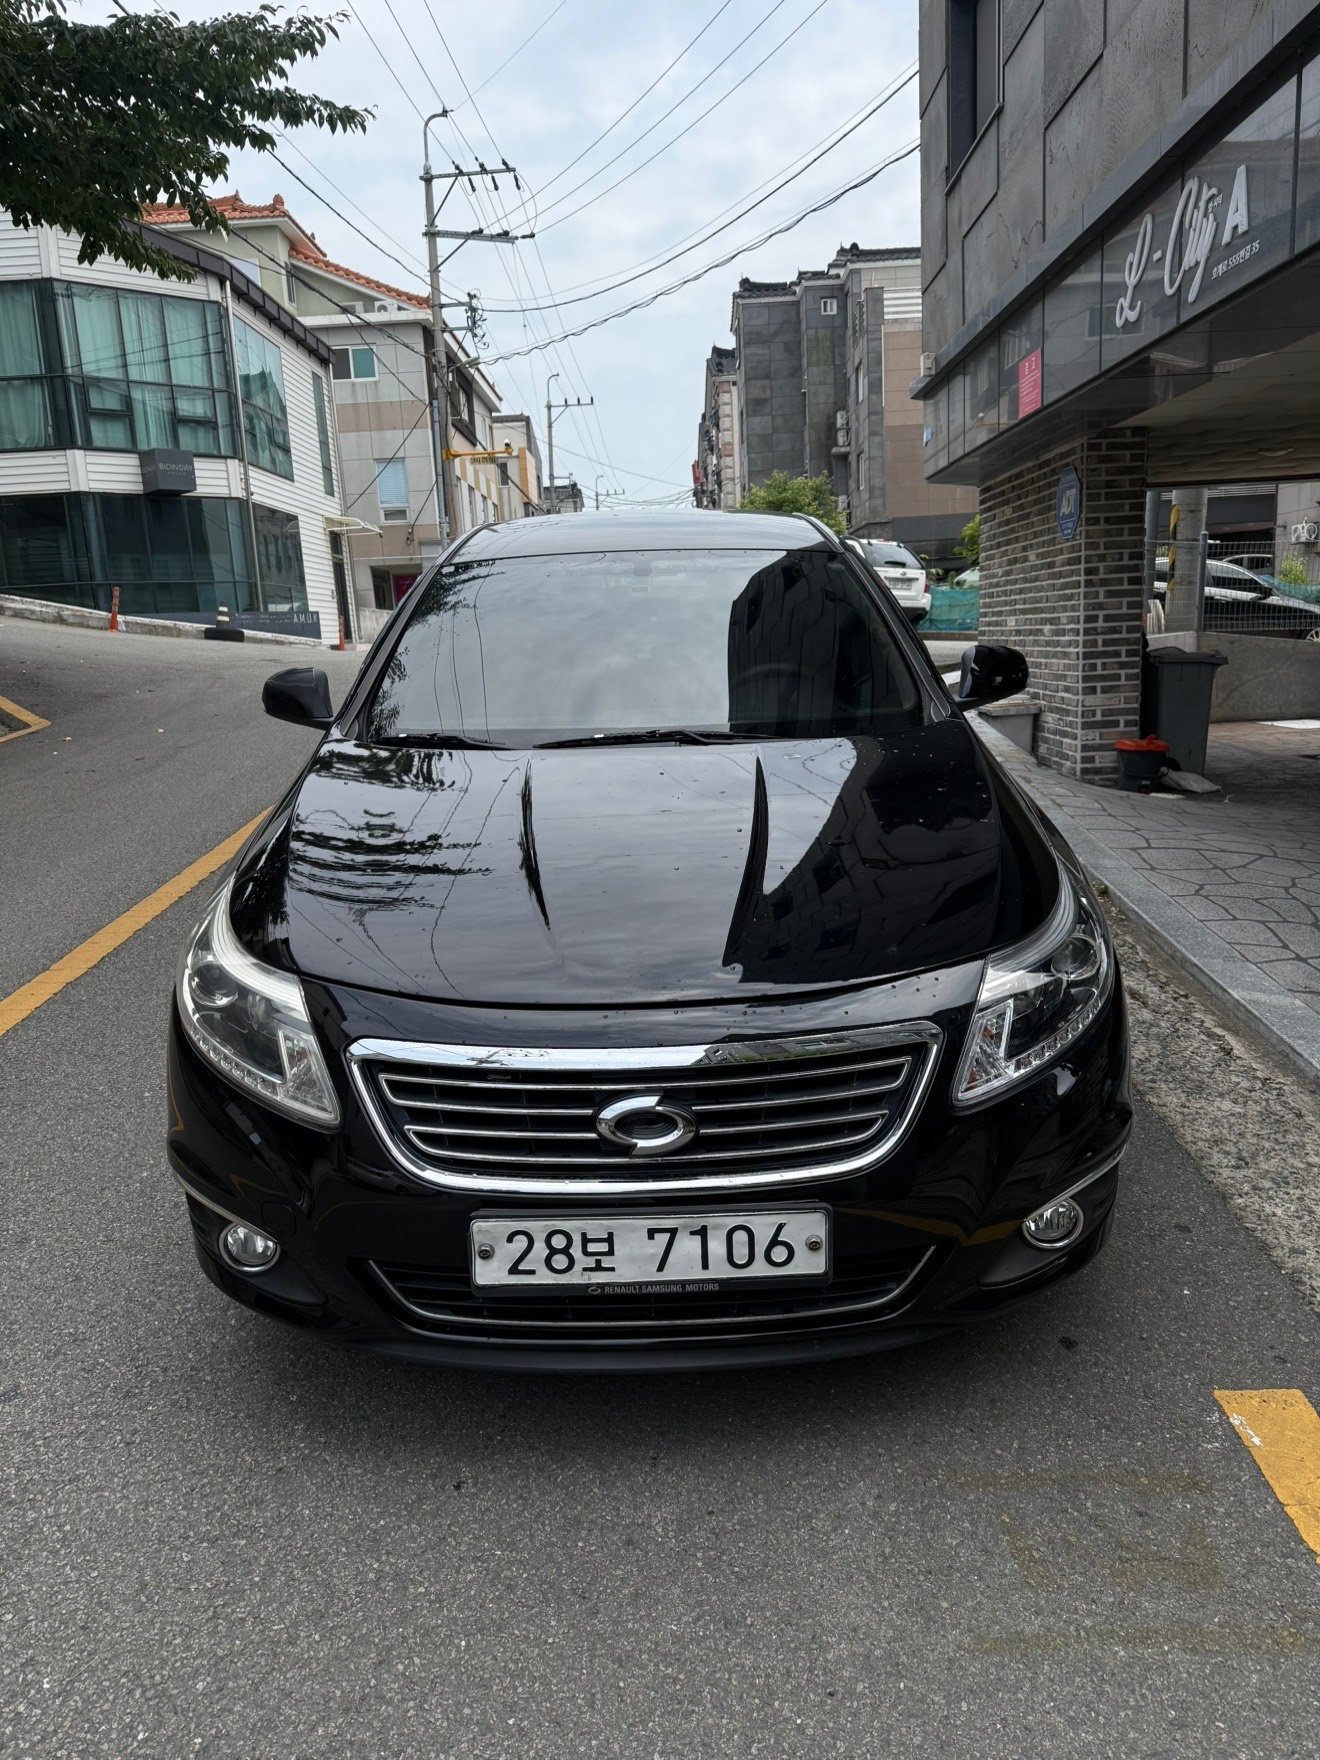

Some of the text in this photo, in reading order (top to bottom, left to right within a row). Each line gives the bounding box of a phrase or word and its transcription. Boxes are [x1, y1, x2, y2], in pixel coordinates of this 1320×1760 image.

[1221, 163, 1249, 246] A
[1228, 243, 1251, 270] 555번길
[1251, 239, 1260, 255] 35
[1060, 488, 1077, 516] ADT
[505, 1221, 796, 1276] 28보 7106
[604, 1282, 719, 1294] RENAULT SAMSUNG MOTORS
